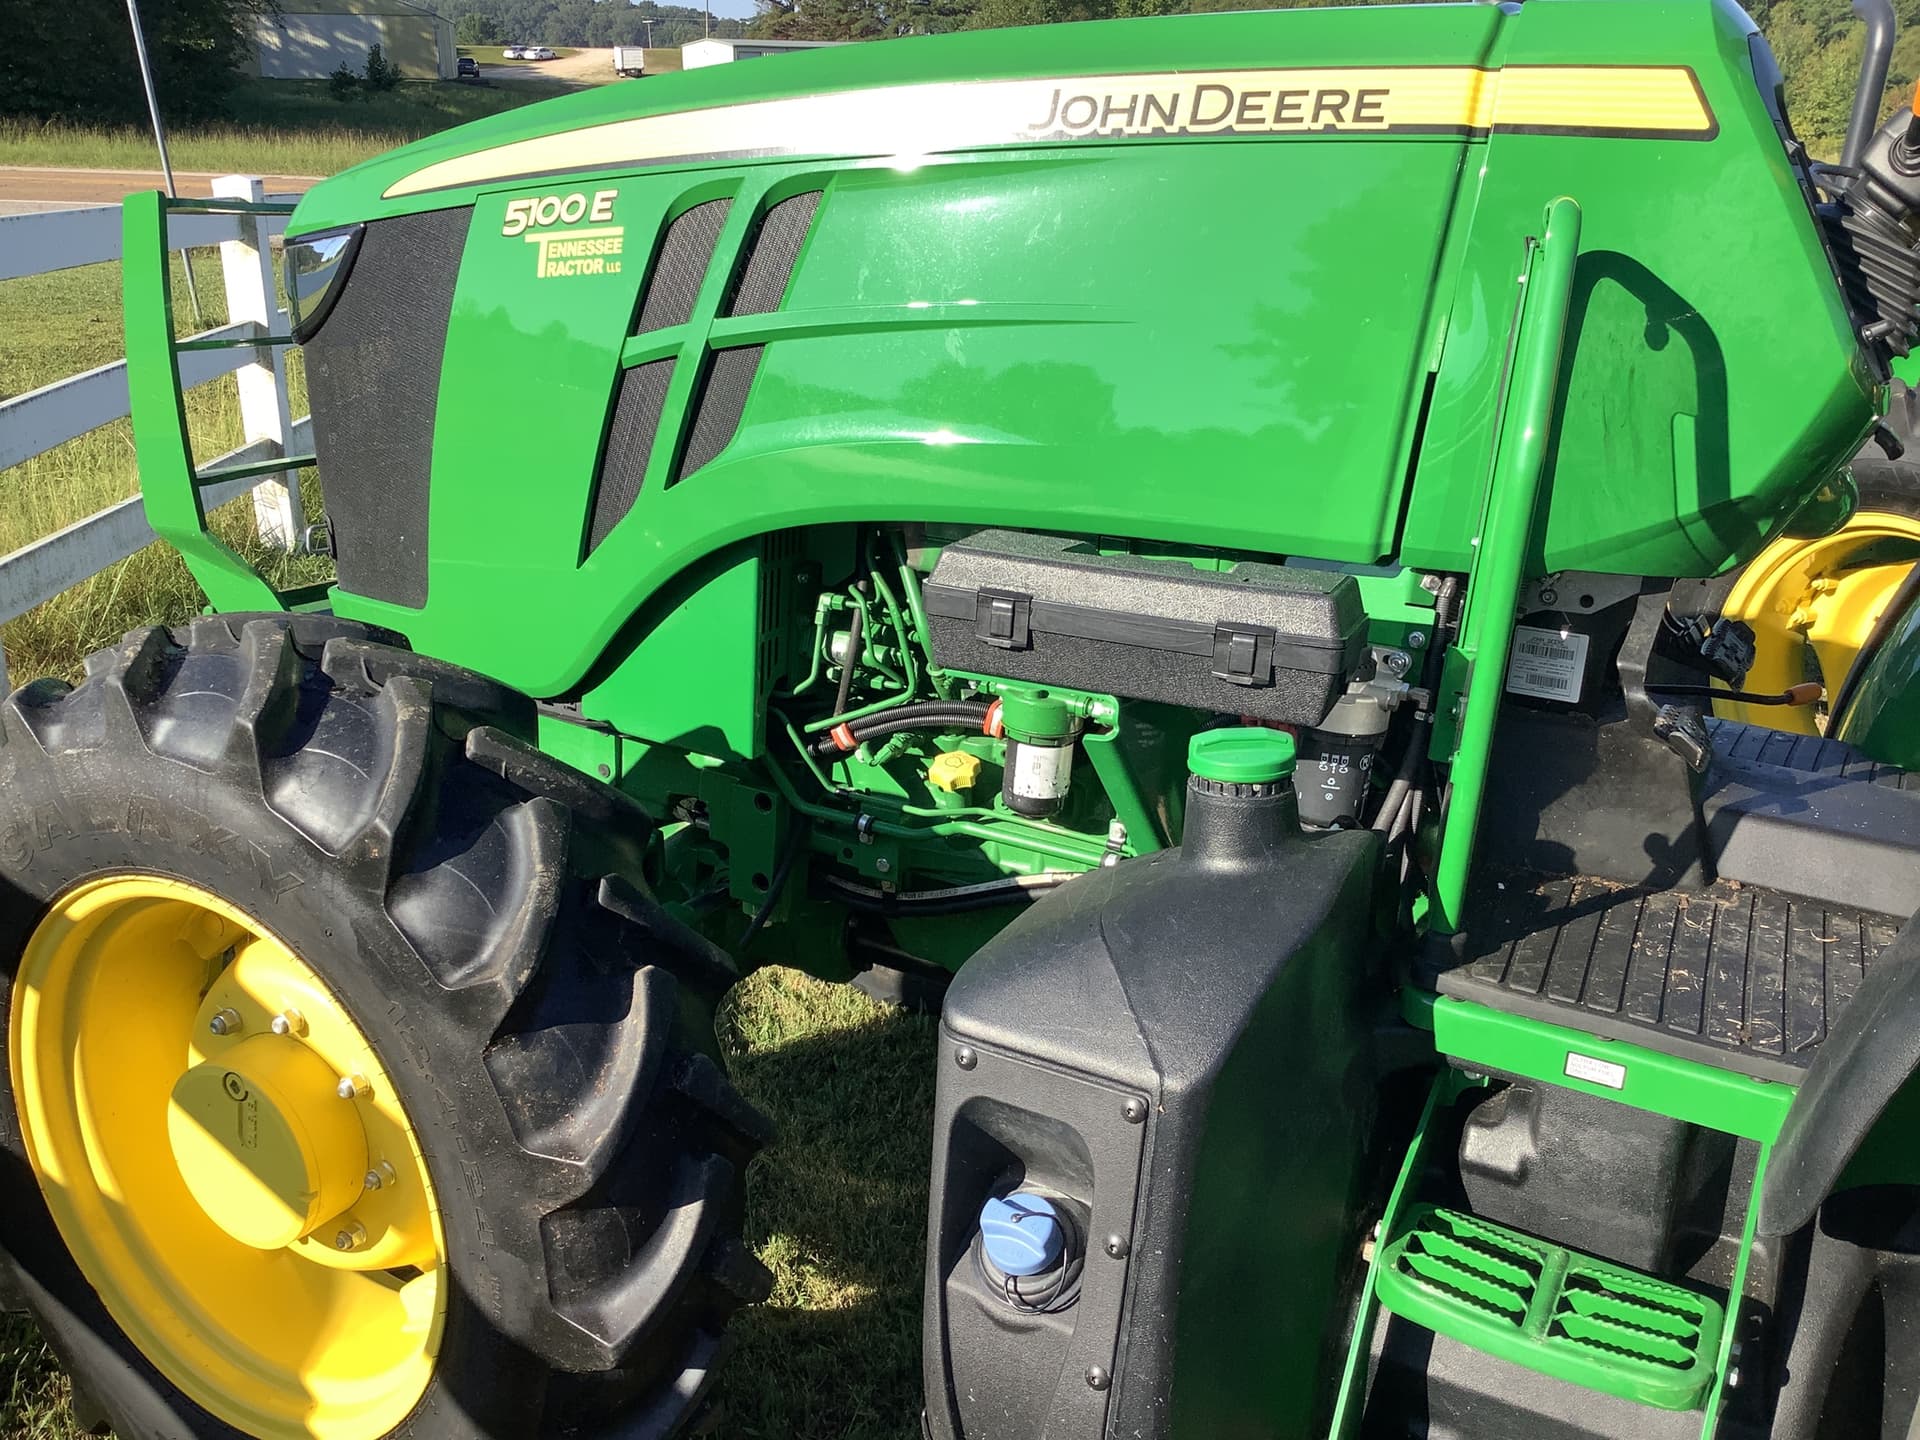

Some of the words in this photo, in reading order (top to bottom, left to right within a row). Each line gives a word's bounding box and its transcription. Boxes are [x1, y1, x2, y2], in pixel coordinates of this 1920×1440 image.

[1028, 88, 1180, 130] JOHN
[1188, 84, 1390, 126] DEERE
[524, 226, 624, 262] TENNESSEE
[537, 257, 605, 278] TRACTOR
[606, 261, 622, 274] LLC
